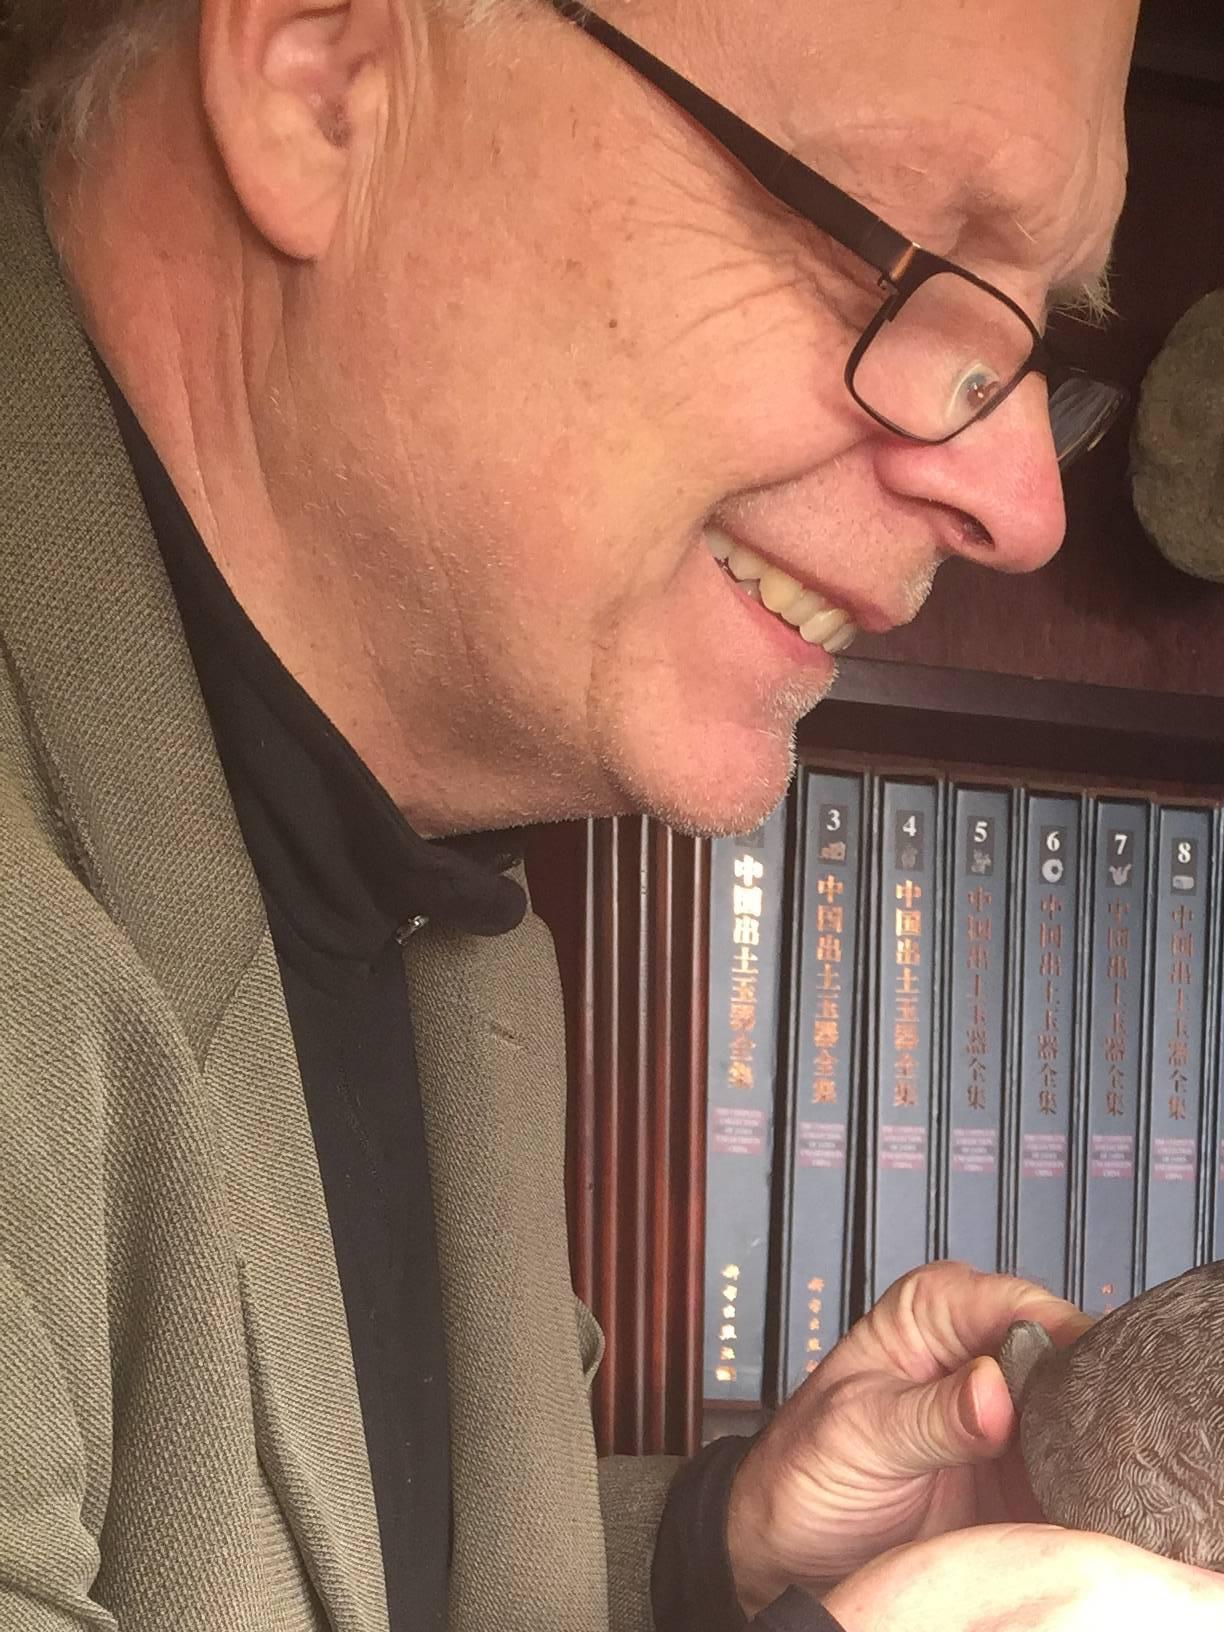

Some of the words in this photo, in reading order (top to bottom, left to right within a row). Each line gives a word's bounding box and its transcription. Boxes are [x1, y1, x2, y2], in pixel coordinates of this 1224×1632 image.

[826, 809, 841, 832] 3
[901, 815, 918, 838] 4
[974, 821, 988, 844] 5
[1045, 830, 1061, 852] 6
[1113, 834, 1128, 856] 7
[1177, 843, 1192, 864] 8
